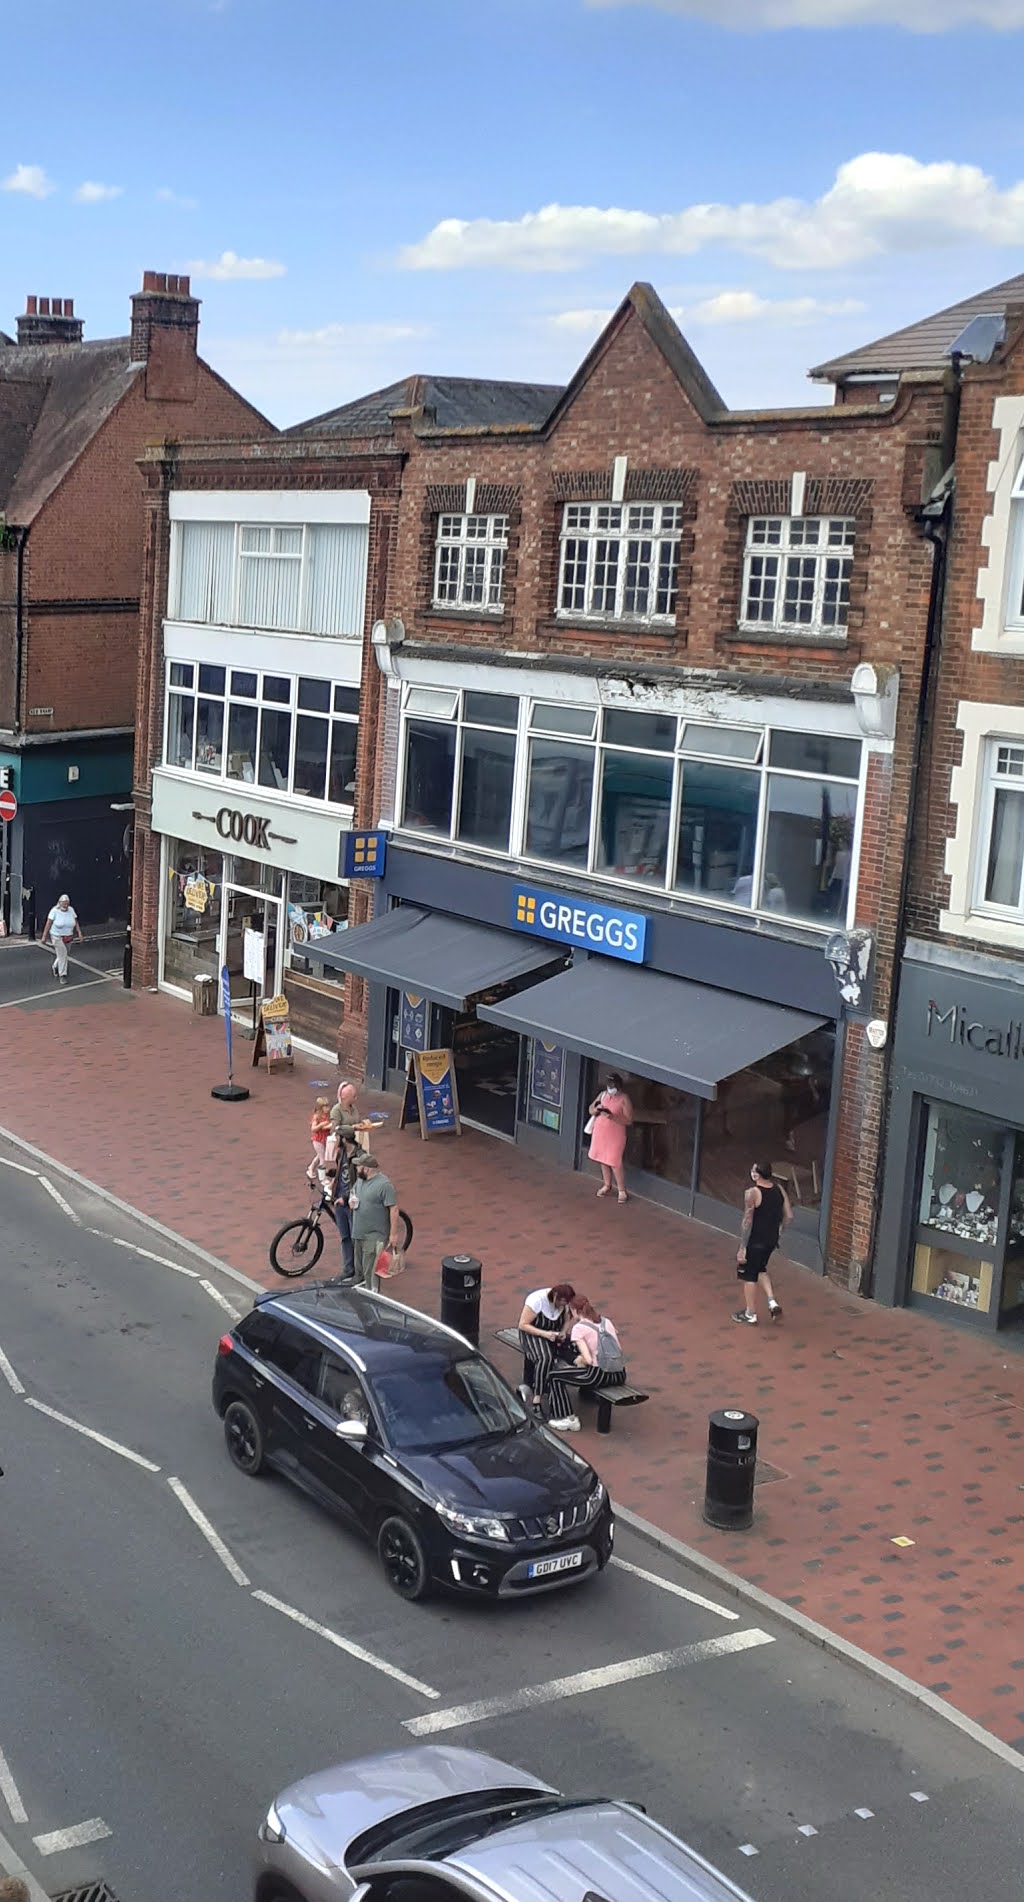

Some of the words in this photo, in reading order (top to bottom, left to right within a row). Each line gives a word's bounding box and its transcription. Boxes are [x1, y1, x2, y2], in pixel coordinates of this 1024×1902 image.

[215, 807, 272, 851] COOK
[353, 865, 376, 873] GREGGS
[539, 901, 638, 951] GREGGS
[927, 1000, 1024, 1060] Micall
[536, 1560, 558, 1575] GD17
[559, 1554, 579, 1569] UVC
